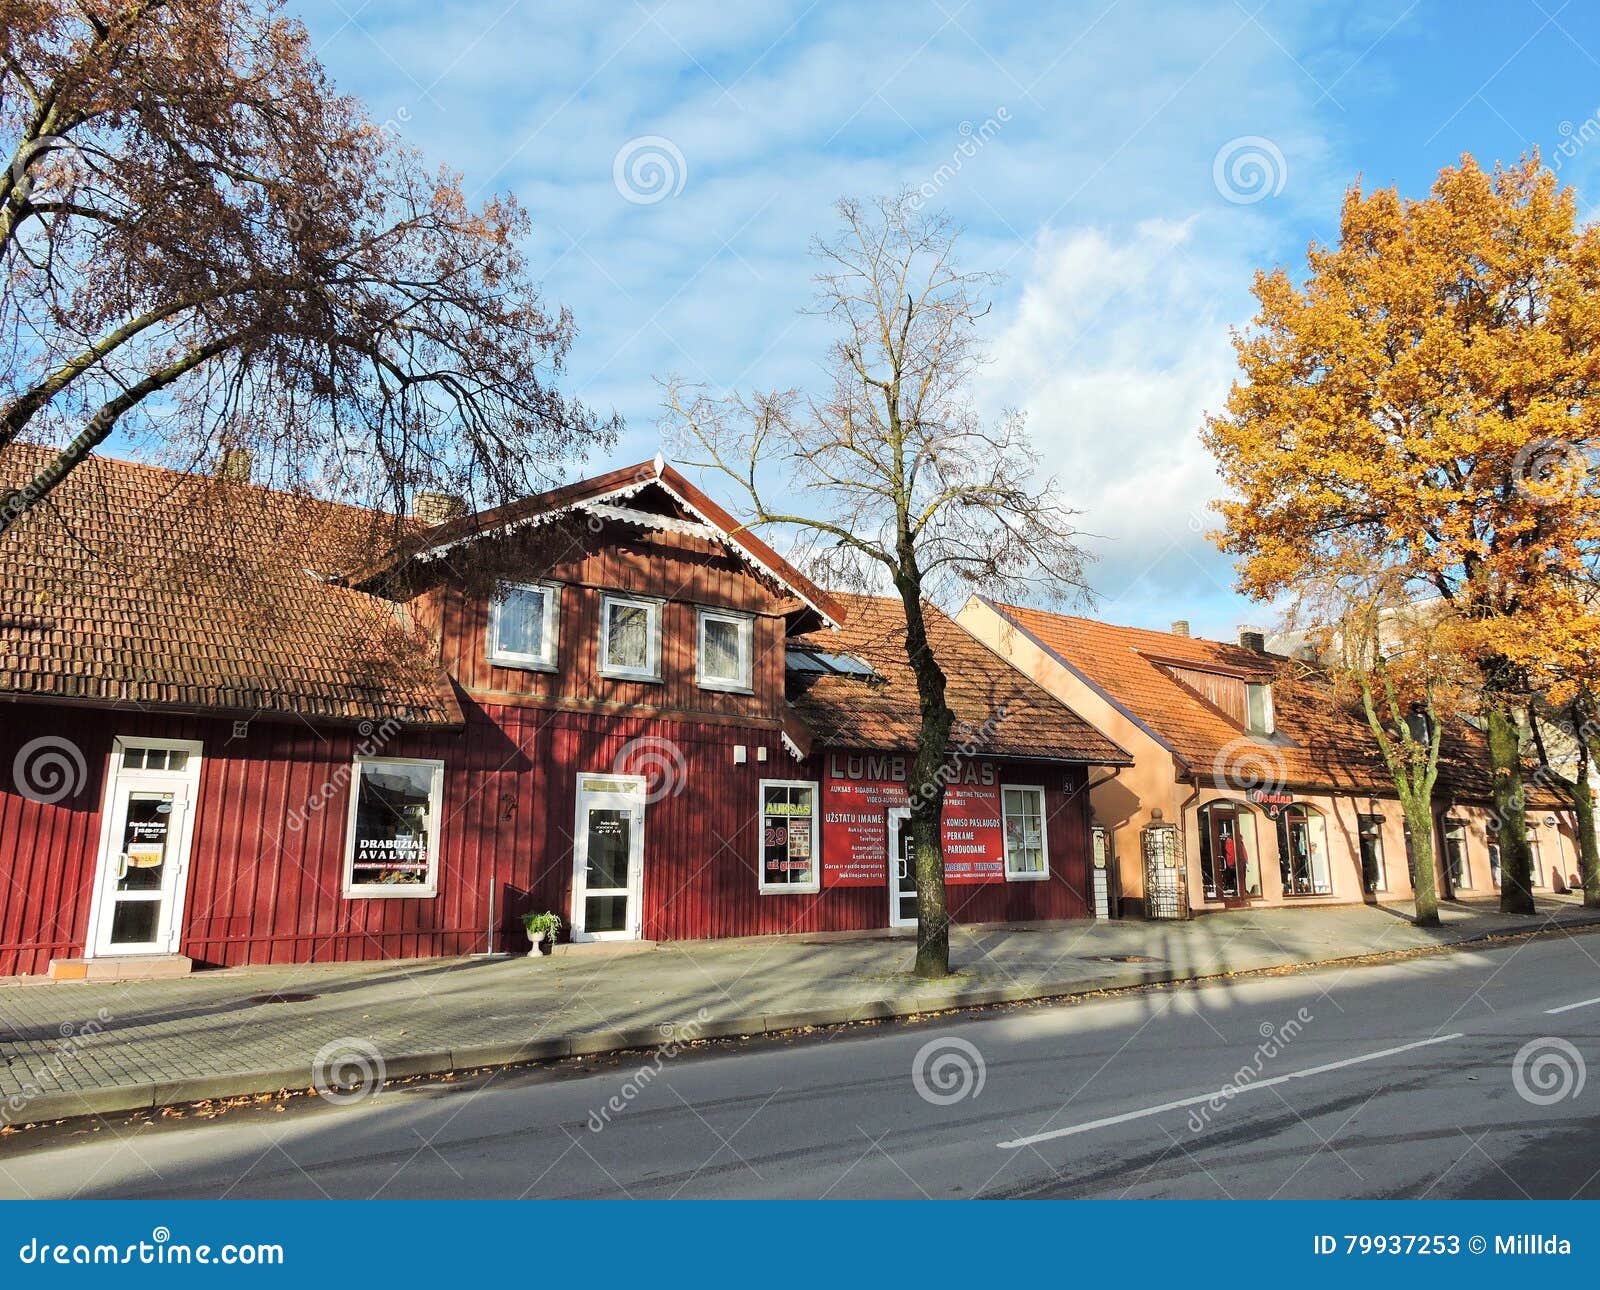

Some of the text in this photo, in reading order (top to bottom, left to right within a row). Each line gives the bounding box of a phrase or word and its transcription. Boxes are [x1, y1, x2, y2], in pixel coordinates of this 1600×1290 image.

[831, 754, 993, 785] LOMBDAS
[765, 827, 788, 847] 29
[946, 831, 975, 841] PERKAME
[947, 844, 986, 854] PARDUODAME
